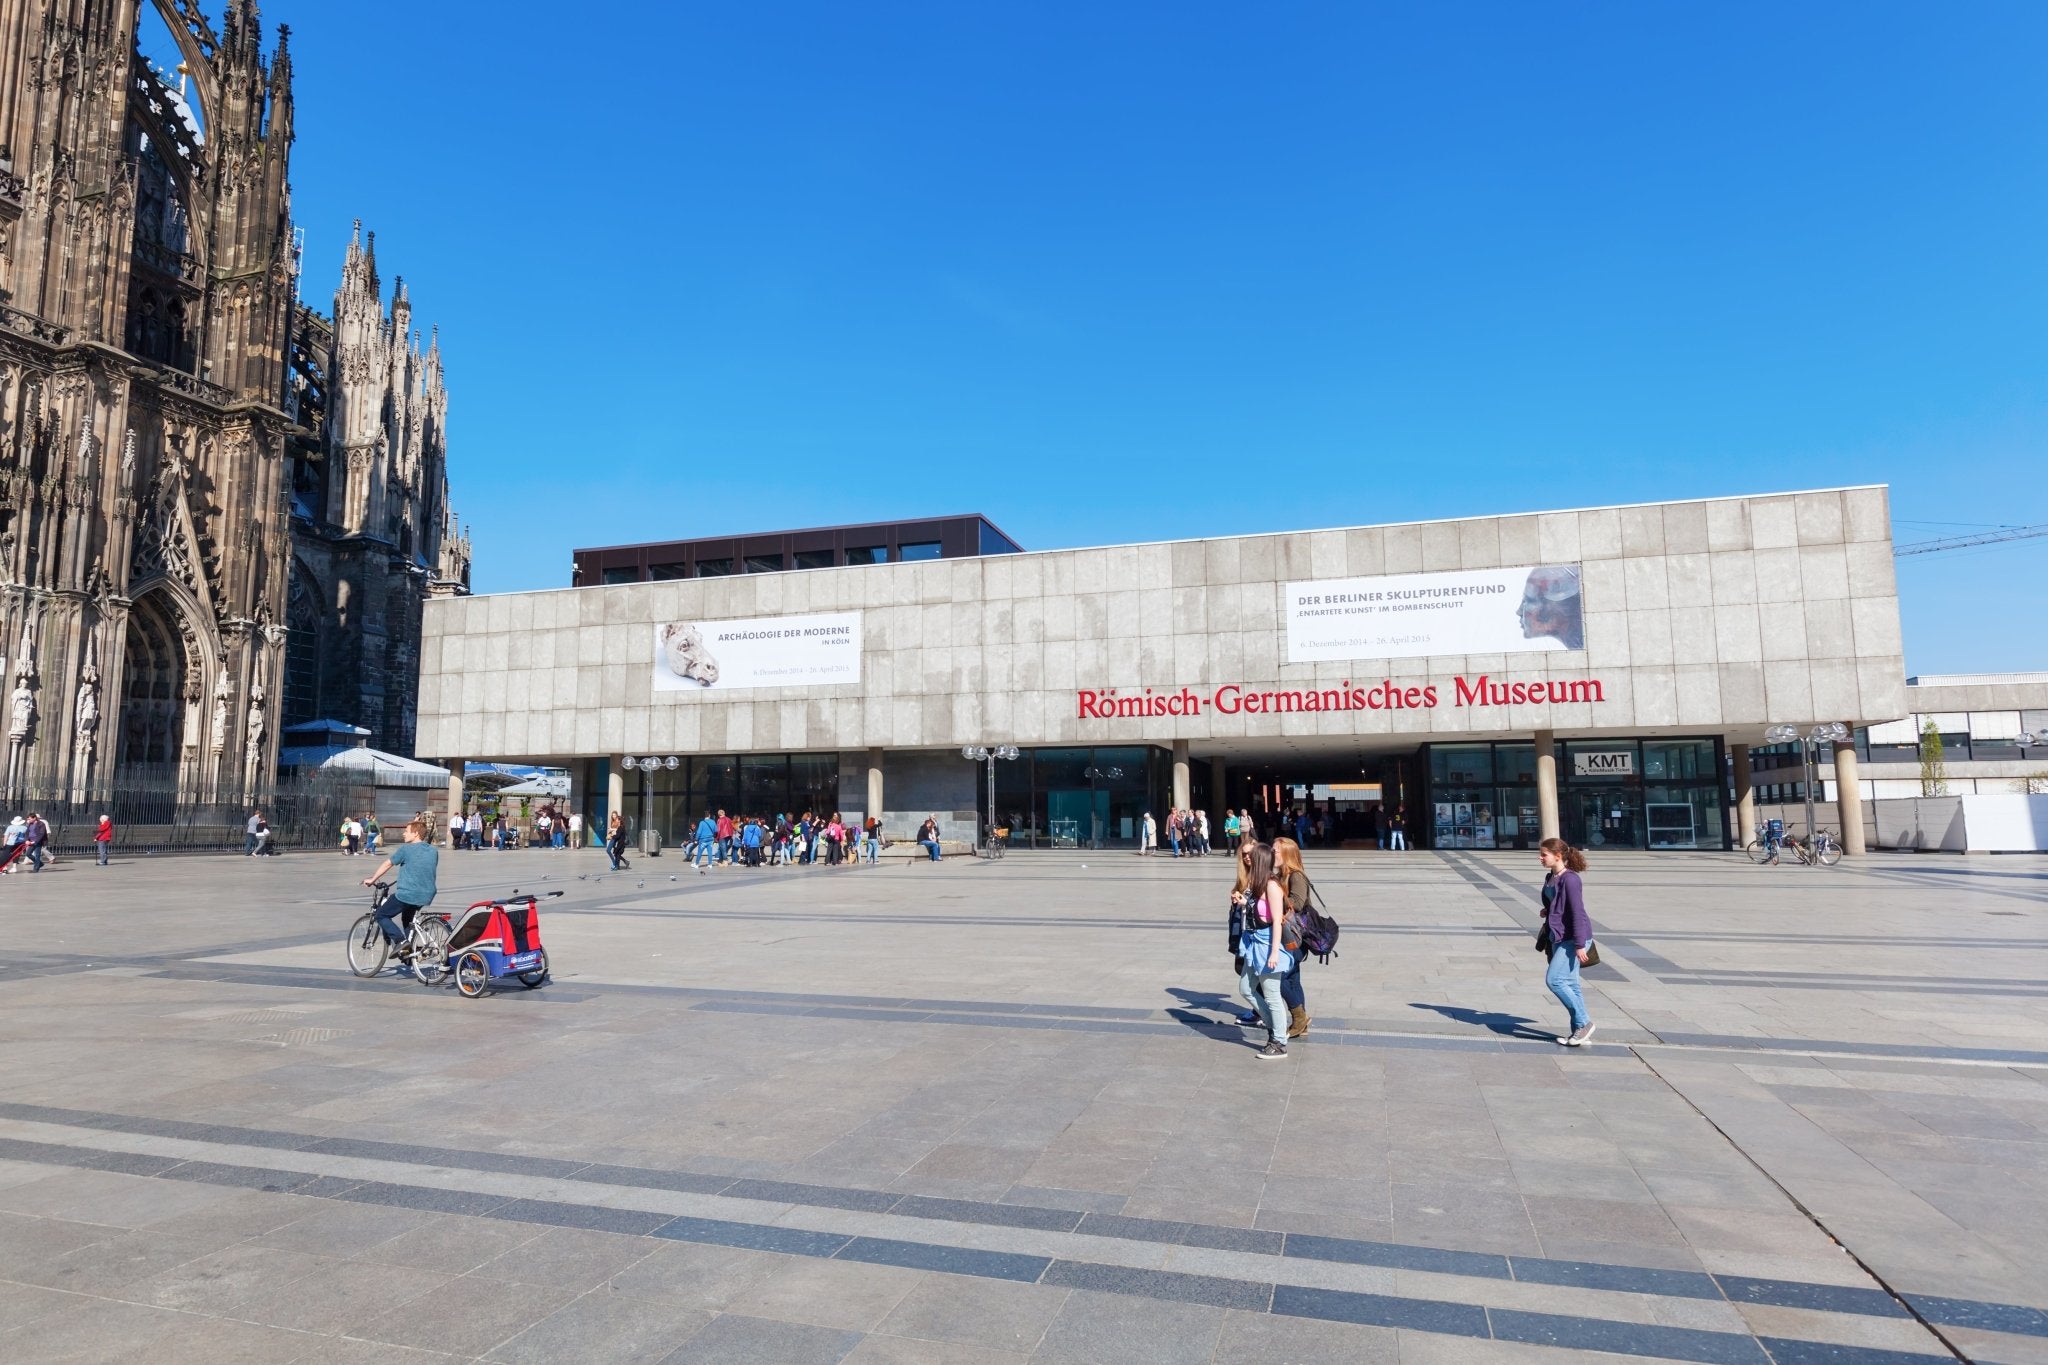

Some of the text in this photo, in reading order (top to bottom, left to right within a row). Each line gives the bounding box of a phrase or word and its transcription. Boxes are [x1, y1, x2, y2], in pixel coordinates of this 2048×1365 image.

[1298, 584, 1506, 606] DER BERLINER SKULPTURENFUND
[1392, 601, 1464, 612] BOMBENSCHUTT
[718, 626, 850, 641] ARCHÄOLOGIE DER MODERNE
[1309, 639, 1347, 648] Dezember
[1349, 638, 1368, 646] 2014
[1390, 635, 1409, 646] April
[1411, 634, 1431, 643] 2015
[1077, 675, 1604, 718] Römisch-Germanisches Museum
[1588, 754, 1629, 768] KMT
